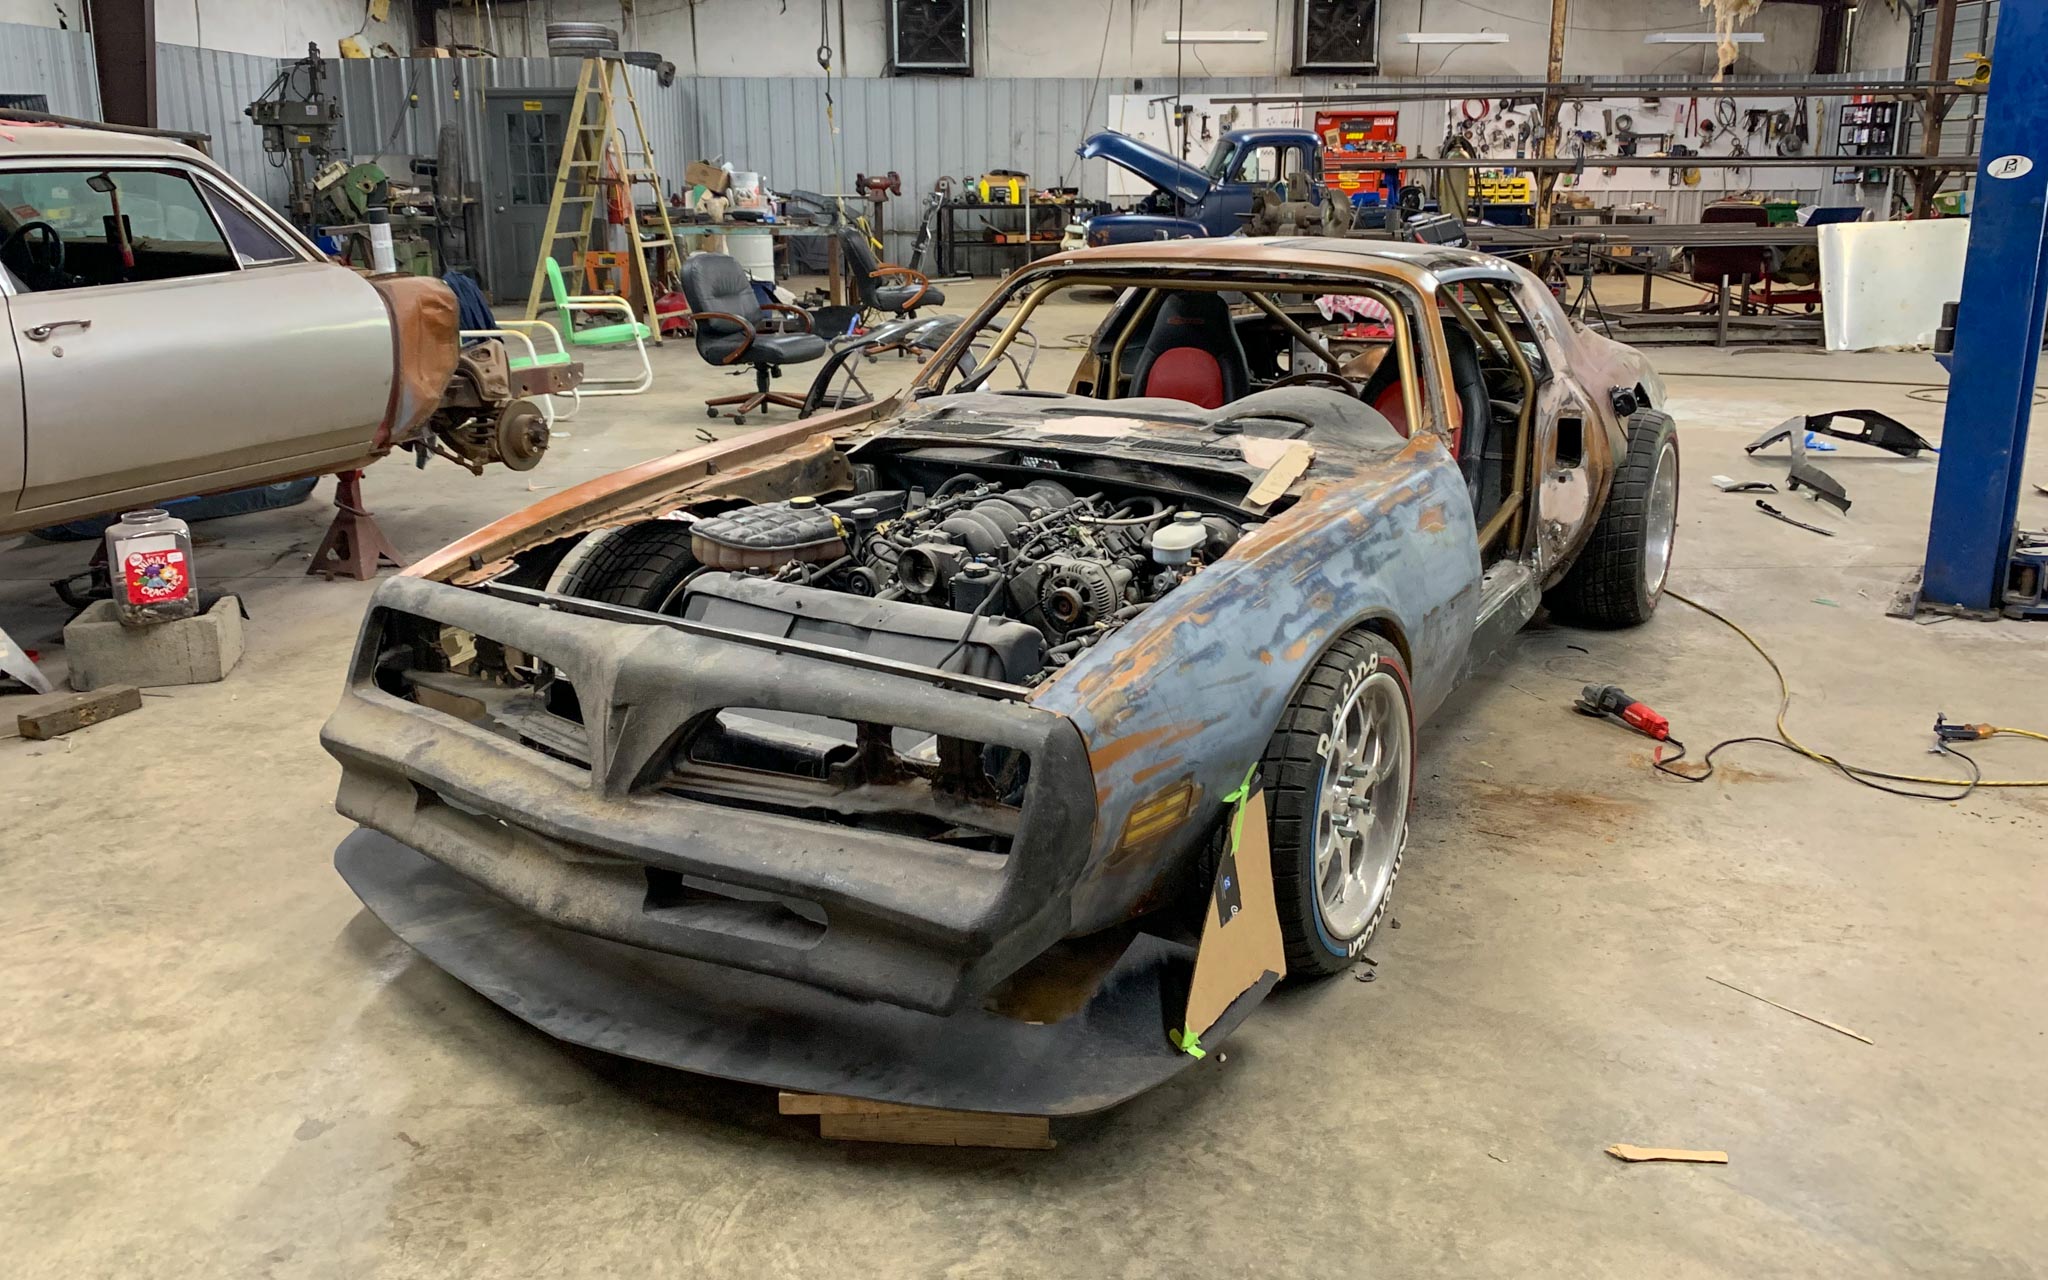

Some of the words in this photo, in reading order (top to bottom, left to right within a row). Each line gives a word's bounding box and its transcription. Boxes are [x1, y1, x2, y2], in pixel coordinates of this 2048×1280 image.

[134, 556, 167, 575] ANIMAL
[141, 575, 184, 597] CRACKERS
[1316, 651, 1378, 759] Racing
